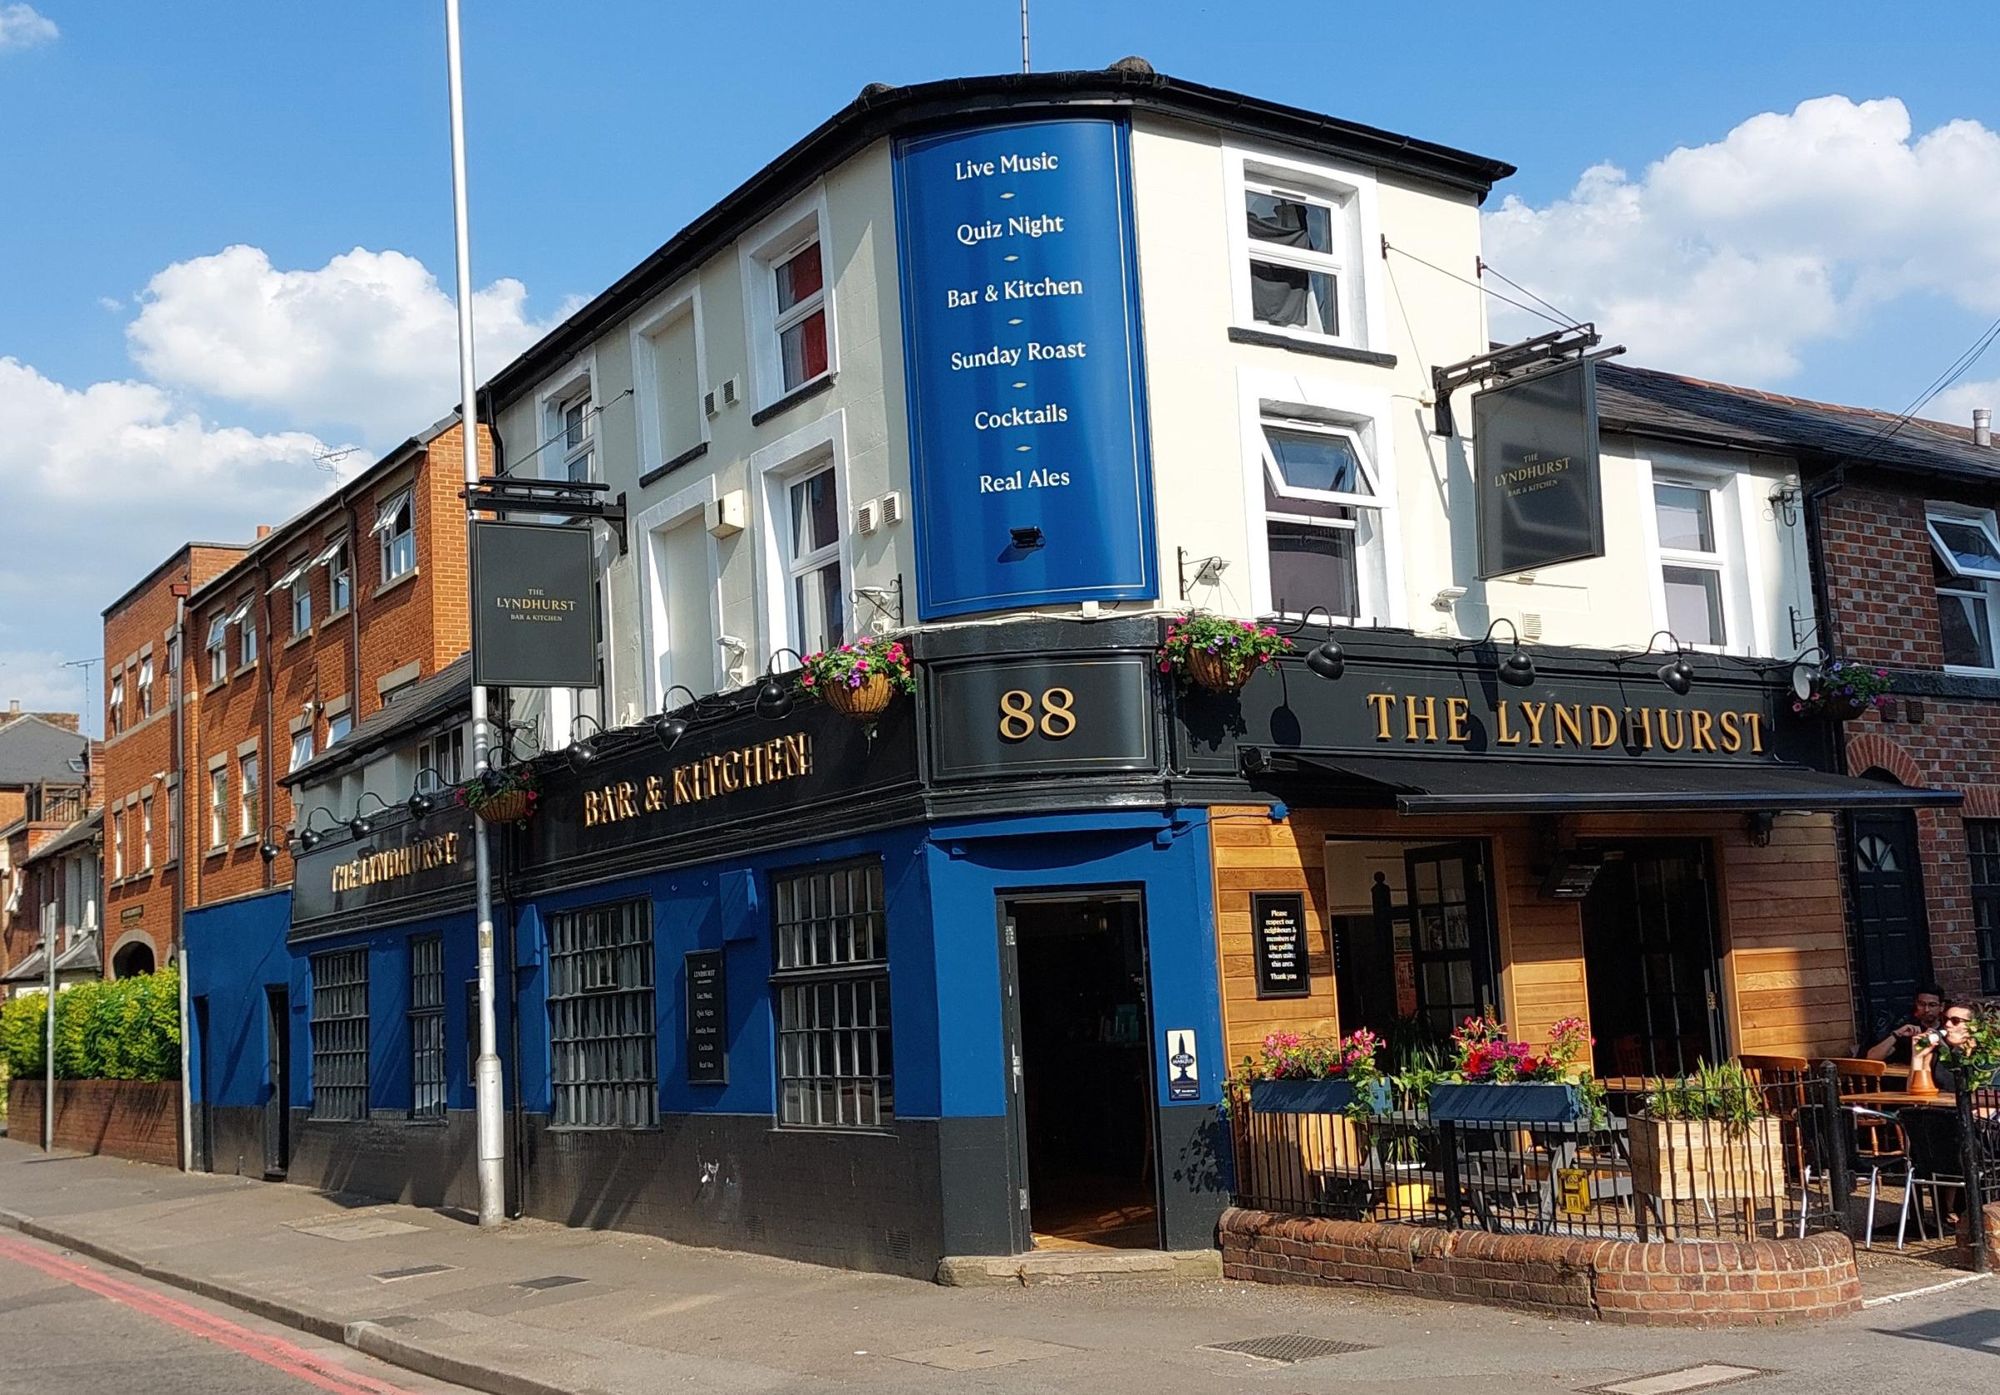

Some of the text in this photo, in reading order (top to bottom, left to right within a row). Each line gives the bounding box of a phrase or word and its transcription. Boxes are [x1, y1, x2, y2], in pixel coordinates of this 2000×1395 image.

[955, 152, 1059, 180] Live Music
[957, 214, 1064, 245] Quiz Night
[947, 277, 1083, 308] Bar & Kitchen
[951, 340, 1087, 371] Sunday Roast
[974, 404, 1068, 430] Cocktails
[1523, 453, 1539, 463] THE
[979, 468, 1070, 493] Real Ales
[1494, 457, 1571, 488] LYNDHURST
[1507, 488, 1521, 497] BAR
[1528, 479, 1558, 492] KITCHEN
[496, 597, 577, 612] LYNDHURST
[528, 588, 544, 596] THE
[532, 614, 563, 622] KITCHEN
[1000, 687, 1076, 738] 88
[1366, 694, 1764, 752] THE LYNDHURST
[584, 731, 813, 828] BAR & KITCHEN
